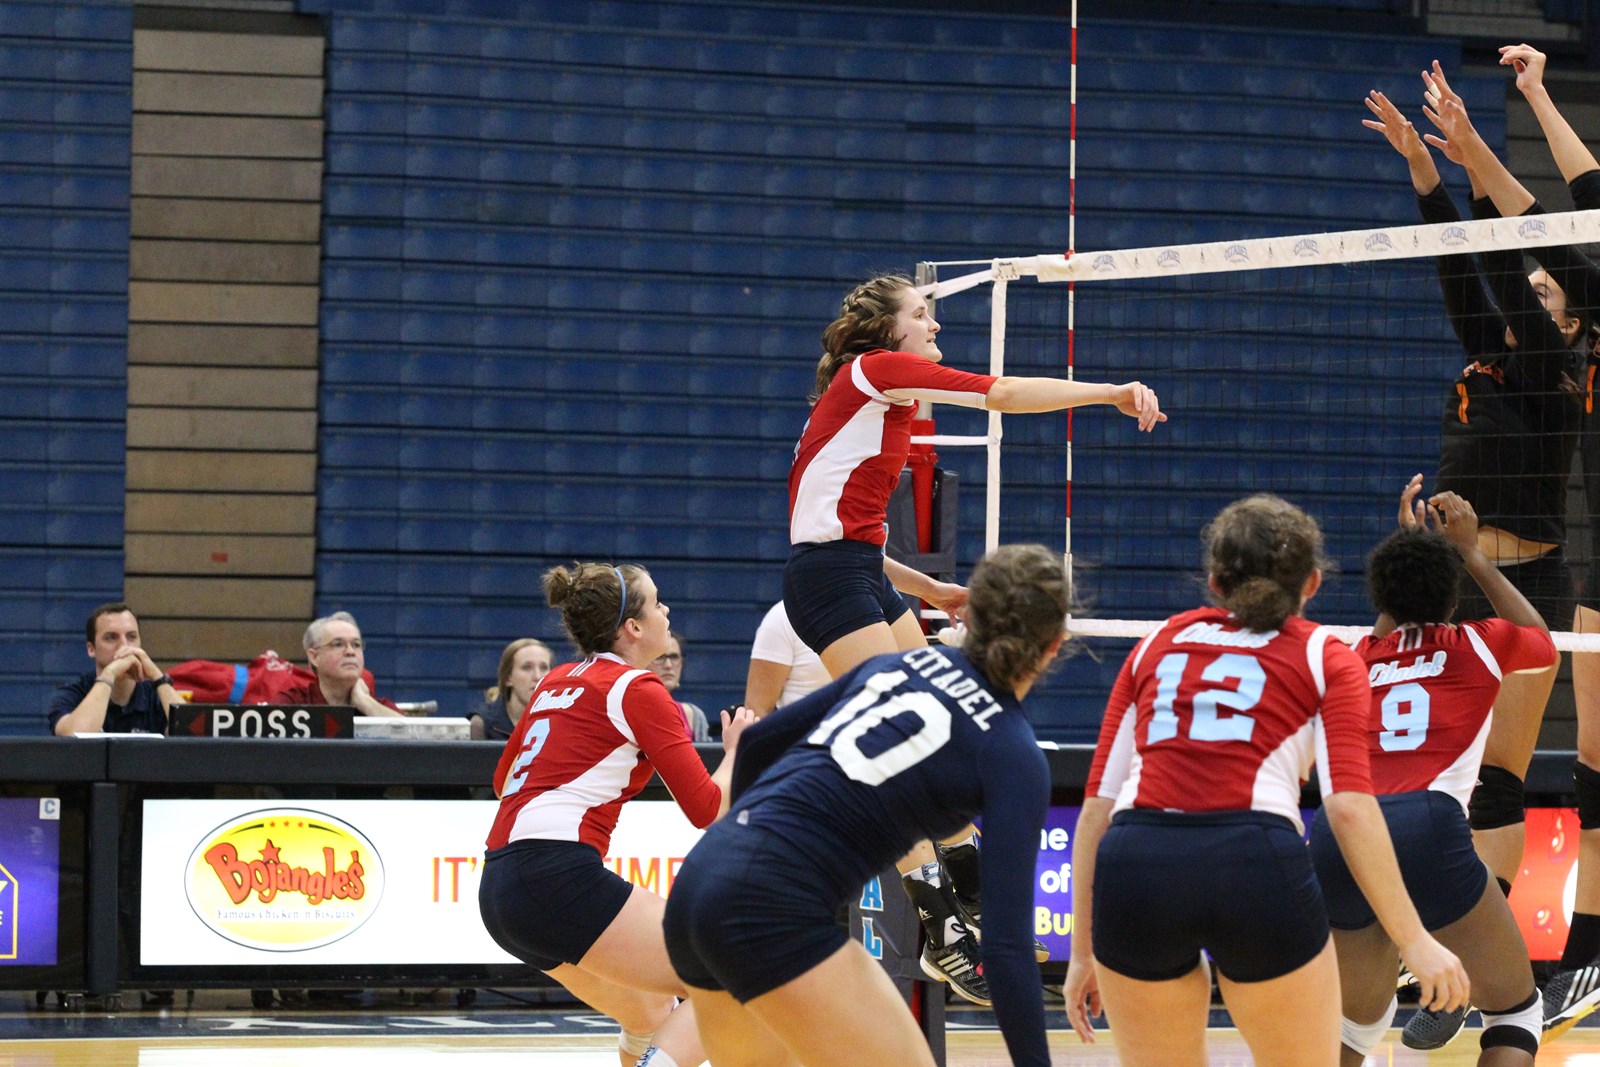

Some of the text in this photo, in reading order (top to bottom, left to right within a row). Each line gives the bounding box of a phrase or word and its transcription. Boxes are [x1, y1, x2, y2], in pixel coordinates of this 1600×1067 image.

[902, 646, 1003, 731] CITADEL
[1146, 653, 1267, 745] 12
[1368, 650, 1447, 688] Citadel
[212, 709, 311, 738] POSS
[807, 670, 952, 787] 10
[1379, 682, 1430, 752] 9
[501, 717, 550, 798] 2
[1040, 863, 1072, 893] of
[1034, 906, 1074, 936] Bu
